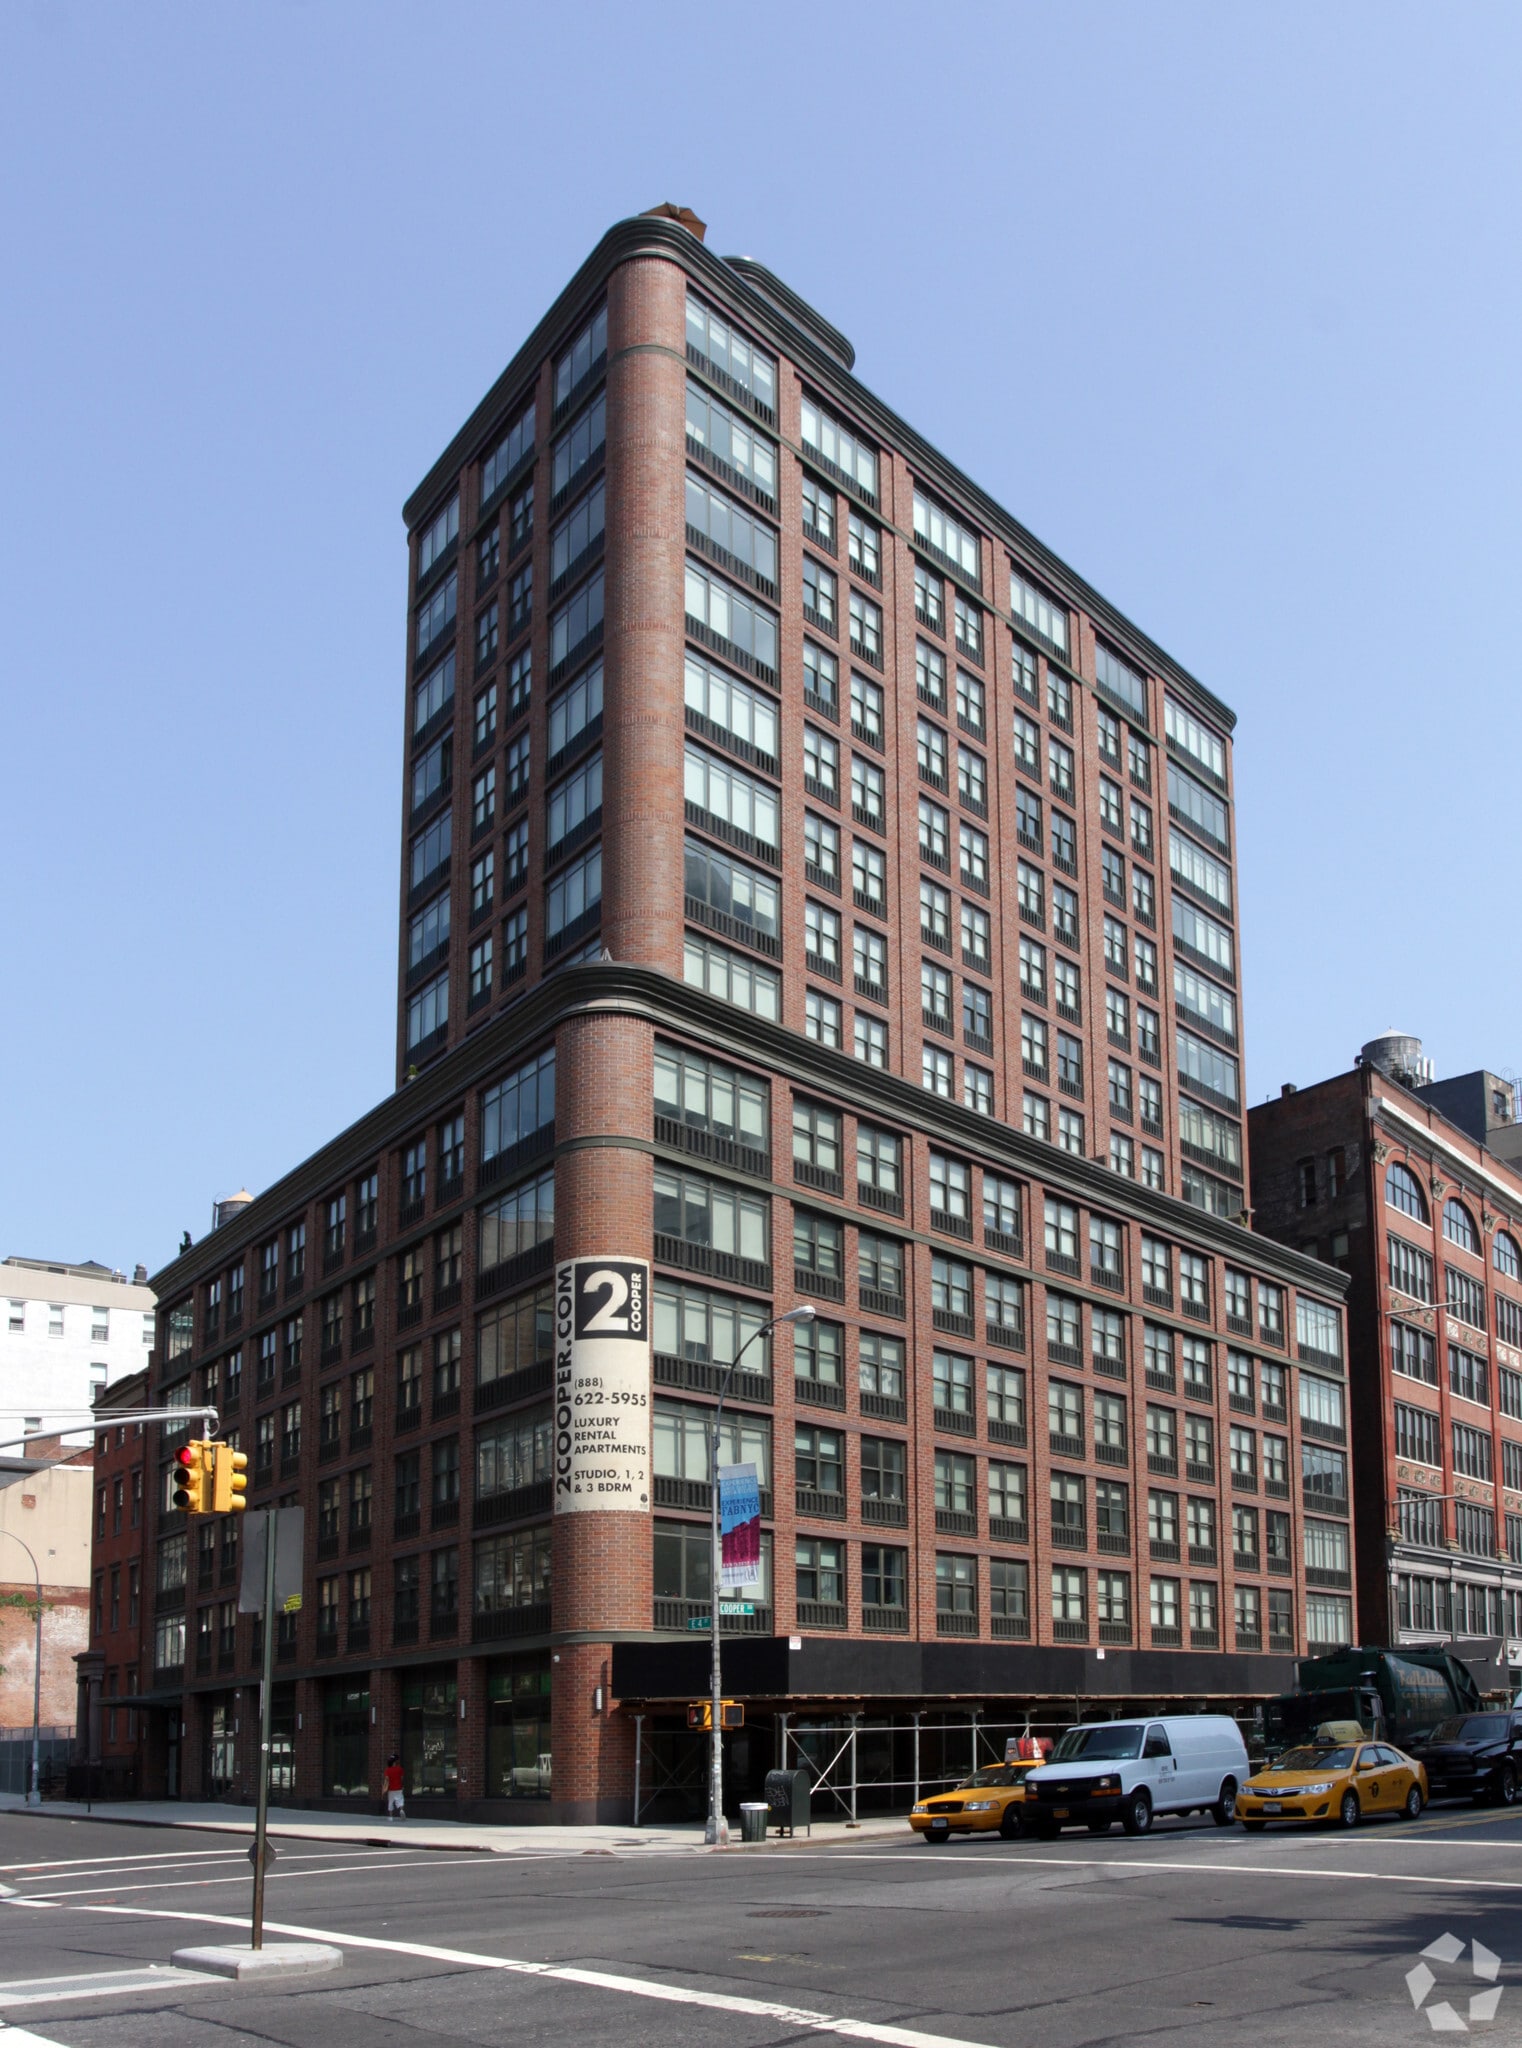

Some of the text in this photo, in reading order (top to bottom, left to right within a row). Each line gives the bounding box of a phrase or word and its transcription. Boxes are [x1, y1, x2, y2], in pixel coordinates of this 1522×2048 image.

[583, 1270, 628, 1331] 2
[631, 1273, 641, 1332] COOPER
[557, 1265, 572, 1494] 2COOPER.COM
[575, 1377, 603, 1389] (888)
[575, 1392, 647, 1406] 622-5955
[575, 1417, 620, 1428] LUXURY
[575, 1431, 616, 1441] RENTAL
[575, 1444, 646, 1455] APARTMENTS
[575, 1469, 621, 1480] STUDIO,
[638, 1471, 644, 1480] 2
[575, 1483, 632, 1493] & 3 BDRM
[721, 1497, 758, 1506] EXPERIENCE
[721, 1503, 760, 1516] FABNYC
[720, 1604, 744, 1613] COOPER
[697, 1618, 703, 1627] 4
